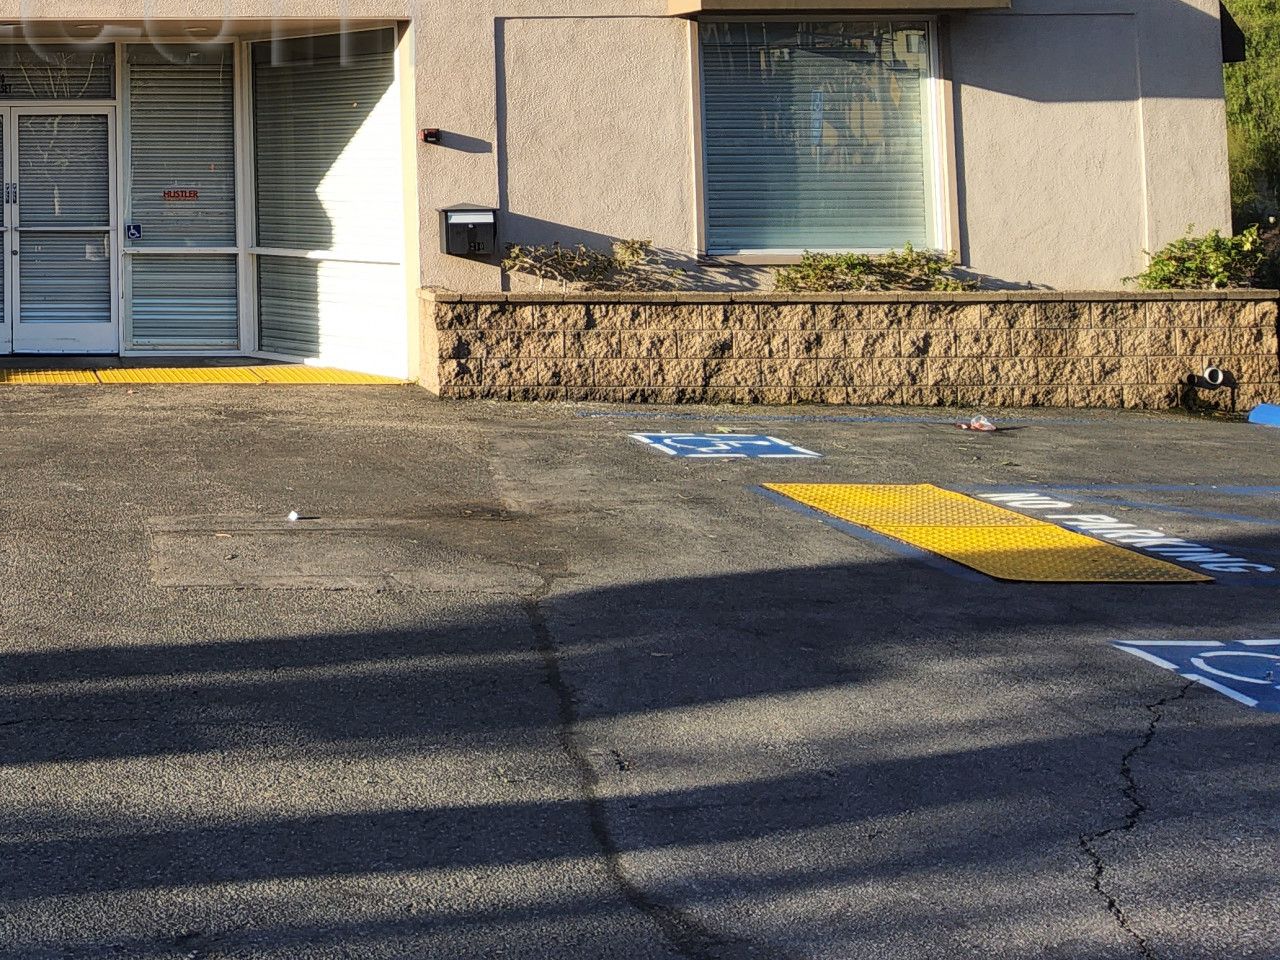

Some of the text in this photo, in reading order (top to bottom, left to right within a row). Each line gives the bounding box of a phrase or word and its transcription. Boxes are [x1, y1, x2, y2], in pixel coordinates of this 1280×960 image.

[163, 190, 199, 199] HUSTLER
[977, 492, 1072, 509] NO
[1045, 514, 1276, 573] PARKING
